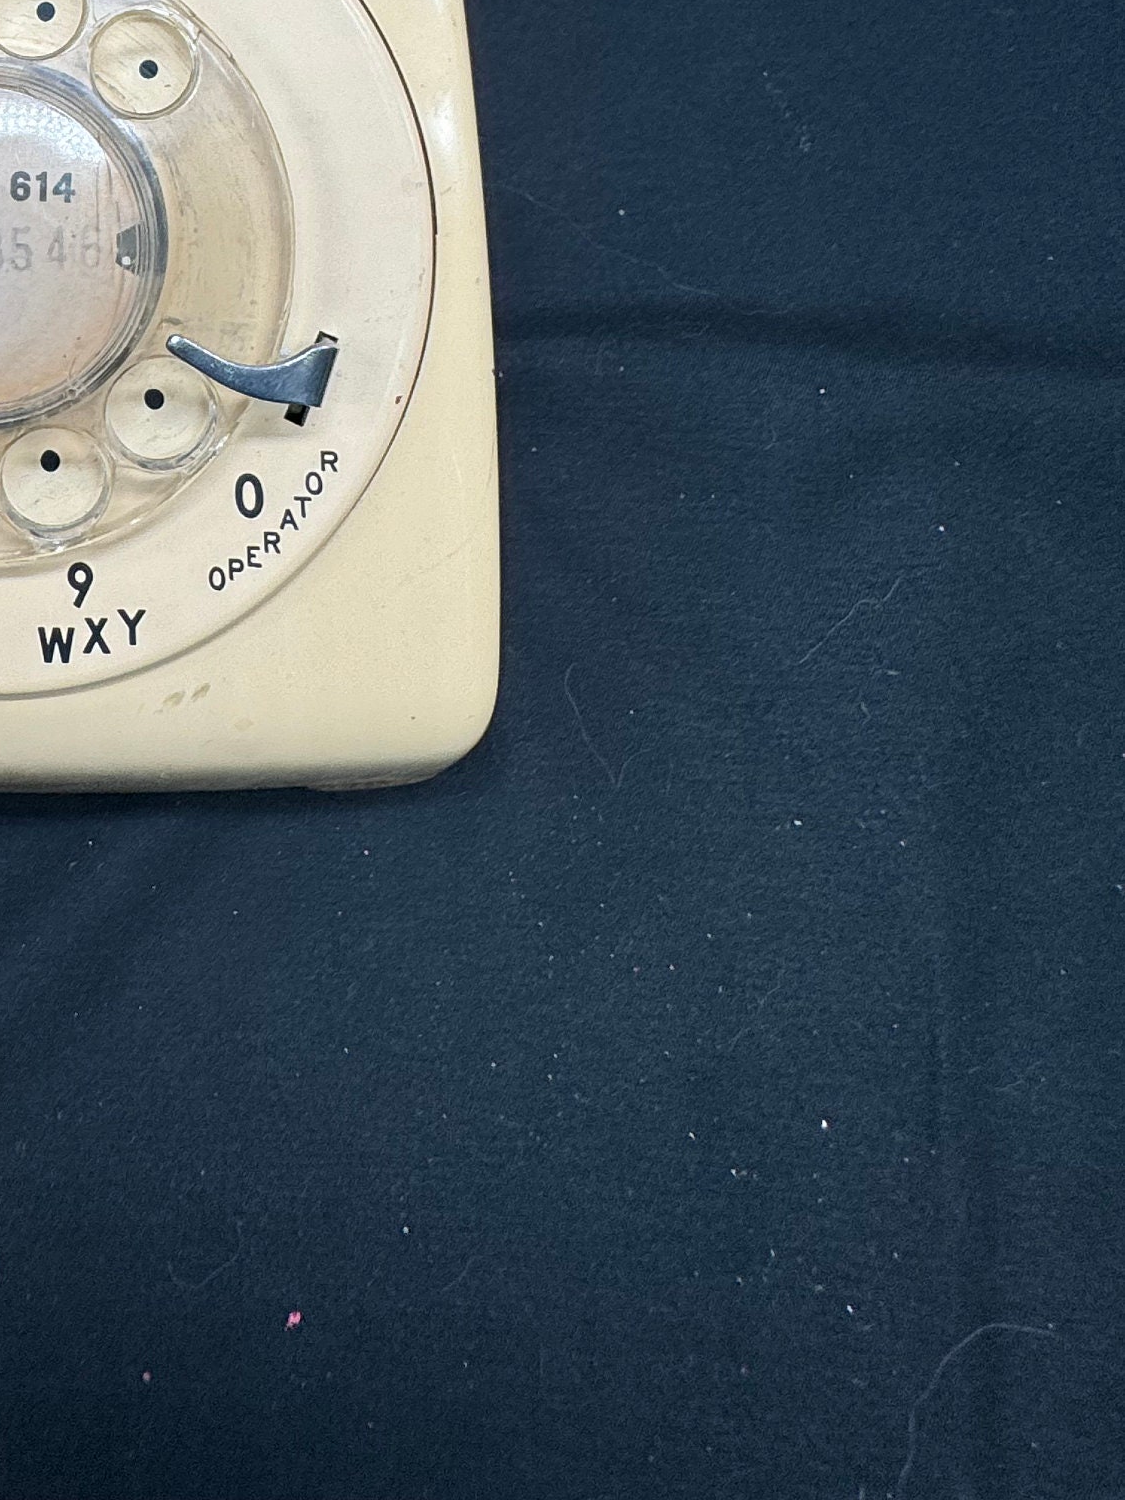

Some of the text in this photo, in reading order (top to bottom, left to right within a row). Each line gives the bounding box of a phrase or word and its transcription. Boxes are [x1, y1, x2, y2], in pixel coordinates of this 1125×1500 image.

[10, 171, 75, 203] 614
[235, 473, 264, 519] 0
[208, 450, 338, 592] OPERATOR
[67, 562, 94, 609] 9
[37, 609, 146, 664] WXY
